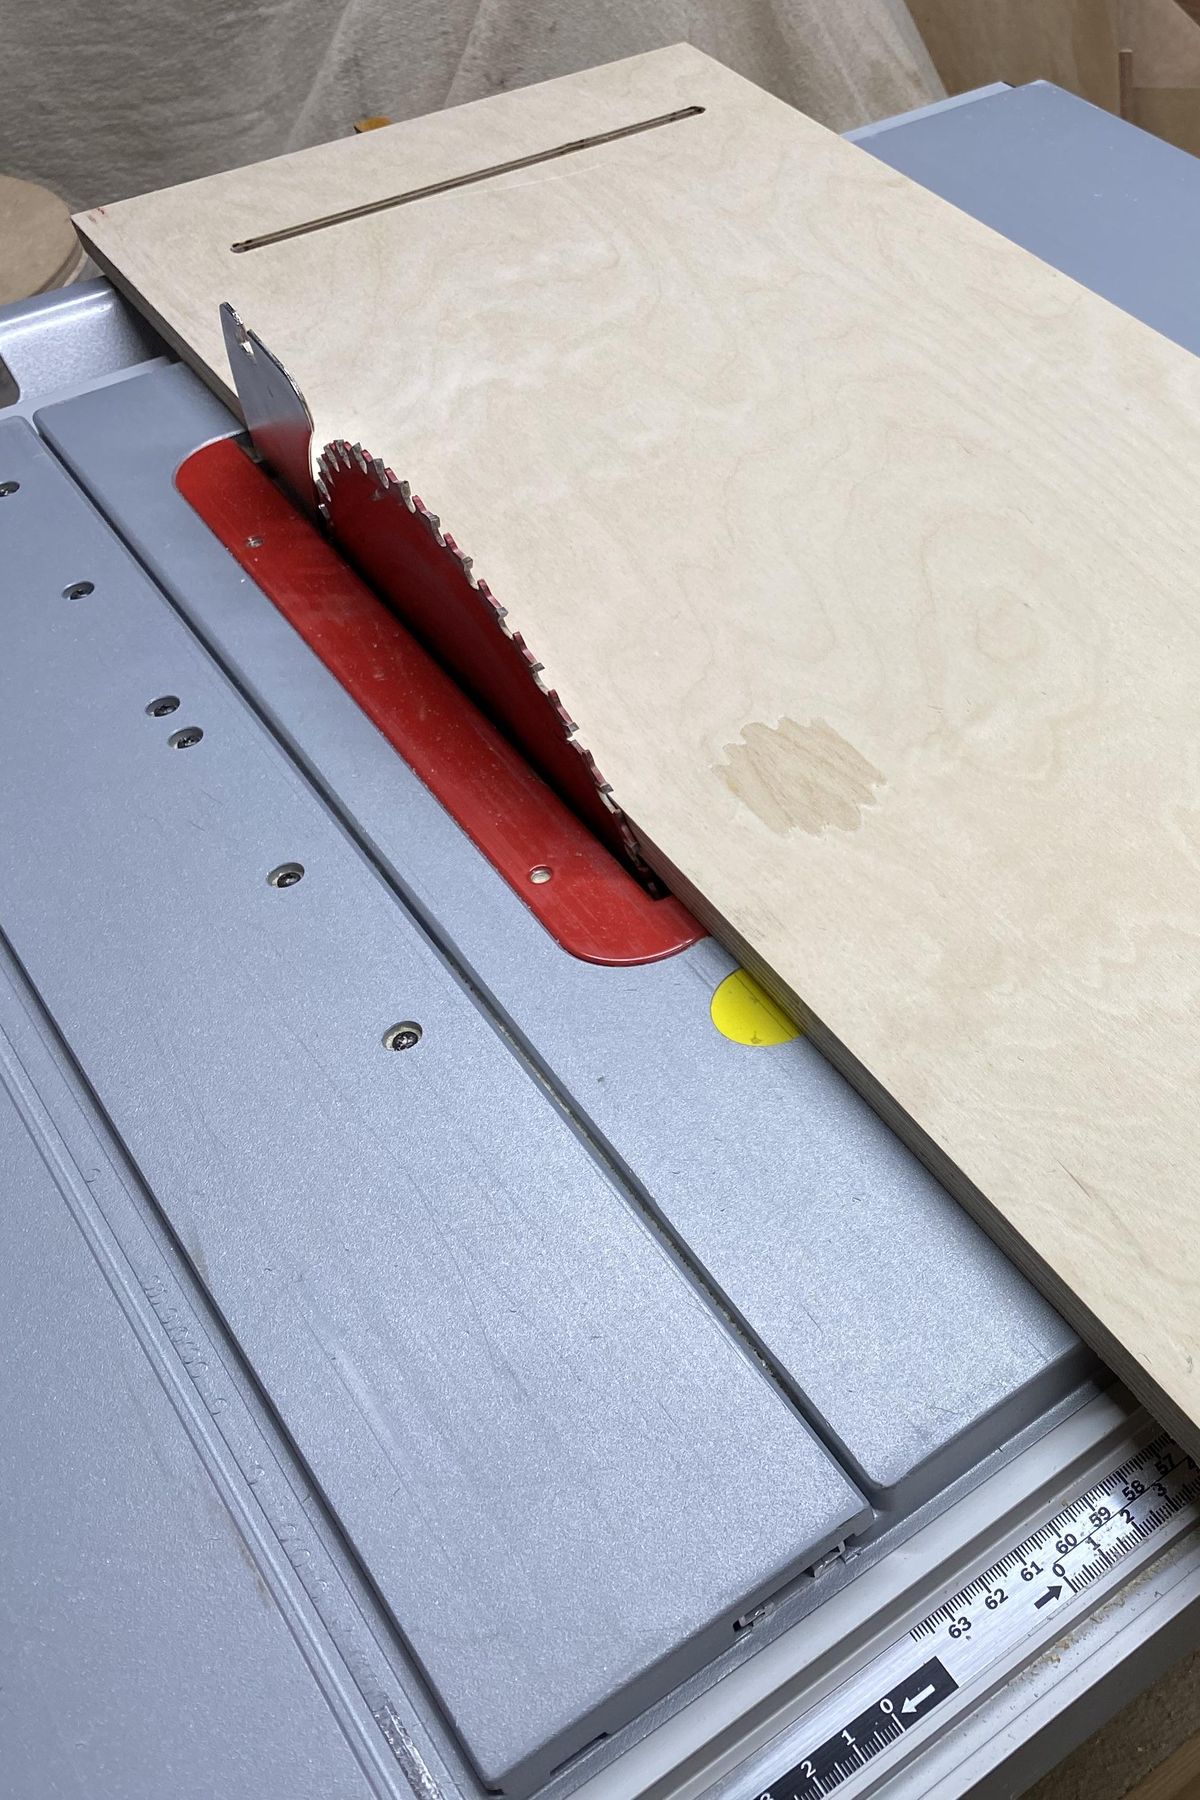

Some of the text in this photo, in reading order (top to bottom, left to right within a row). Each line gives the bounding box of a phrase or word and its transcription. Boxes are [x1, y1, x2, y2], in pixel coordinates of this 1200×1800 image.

[948, 1452, 1176, 1639] 63 62 61 60 59 58 57
[1052, 1563, 1066, 1578] 0
[1086, 1535, 1102, 1551] 1
[1120, 1508, 1135, 1524] 2
[1153, 1481, 1168, 1497] 3
[800, 1698, 894, 1779] 2 1 0
